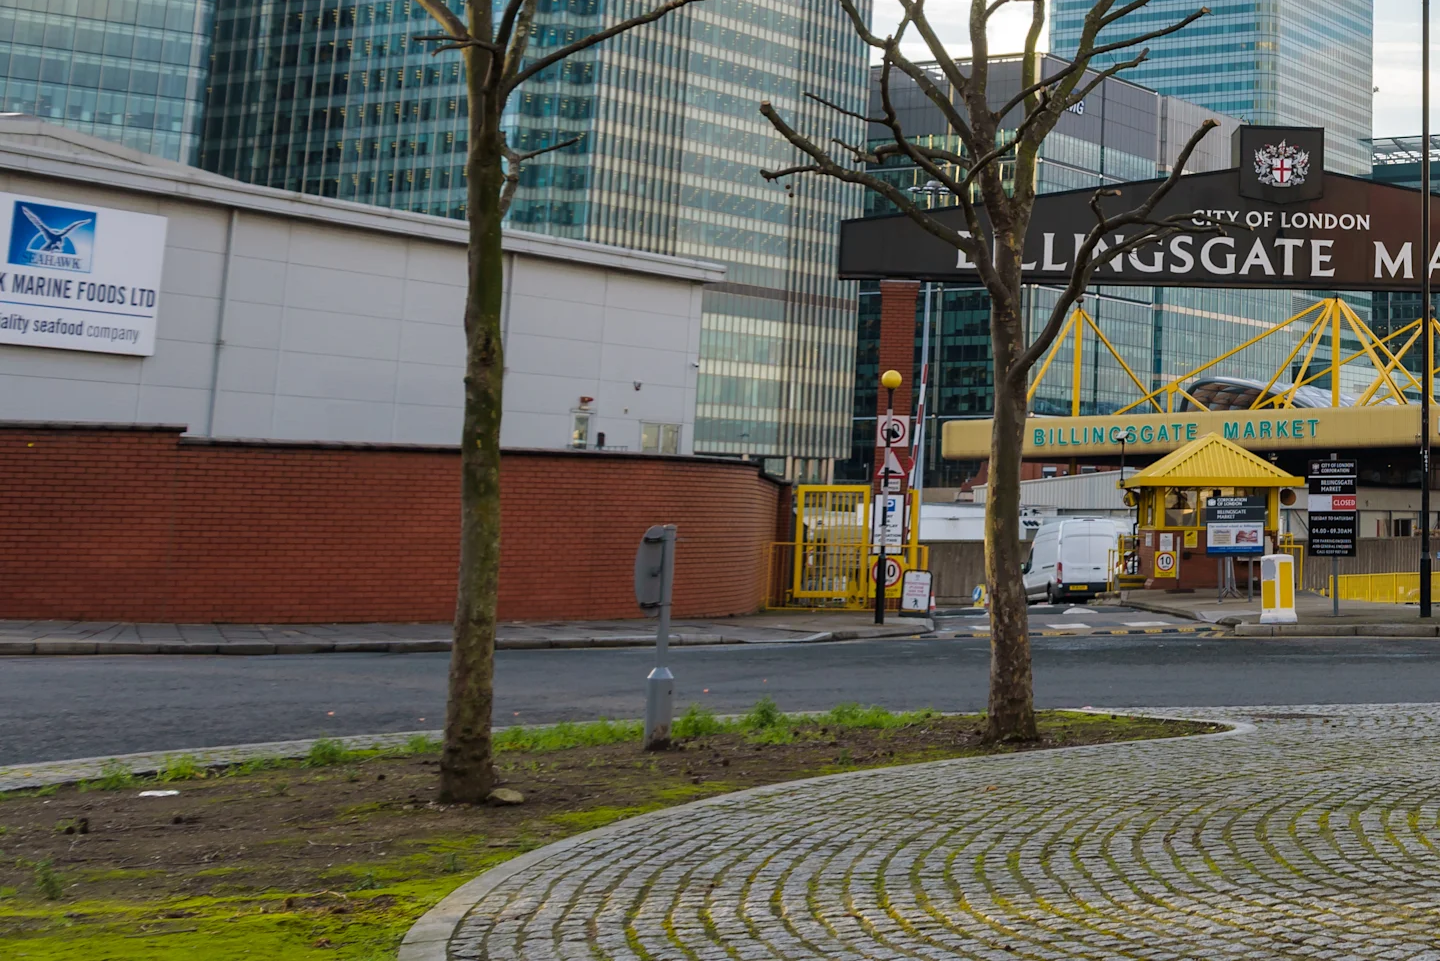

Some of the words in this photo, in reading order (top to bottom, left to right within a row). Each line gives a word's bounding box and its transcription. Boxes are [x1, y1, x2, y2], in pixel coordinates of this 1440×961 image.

[1191, 209, 1238, 226] CITY
[1245, 210, 1273, 228] OF
[1280, 212, 1371, 231] LONDON
[22, 252, 83, 269] SEAHAWK
[12, 274, 73, 299] MARINE
[77, 281, 126, 305] FOODS
[130, 288, 156, 308] LTD
[33, 318, 84, 336] seafood
[87, 324, 140, 344] company
[1033, 423, 1198, 446] BILLINGSGATE
[1224, 419, 1319, 439] MARKET
[1160, 556, 1171, 565] 10
